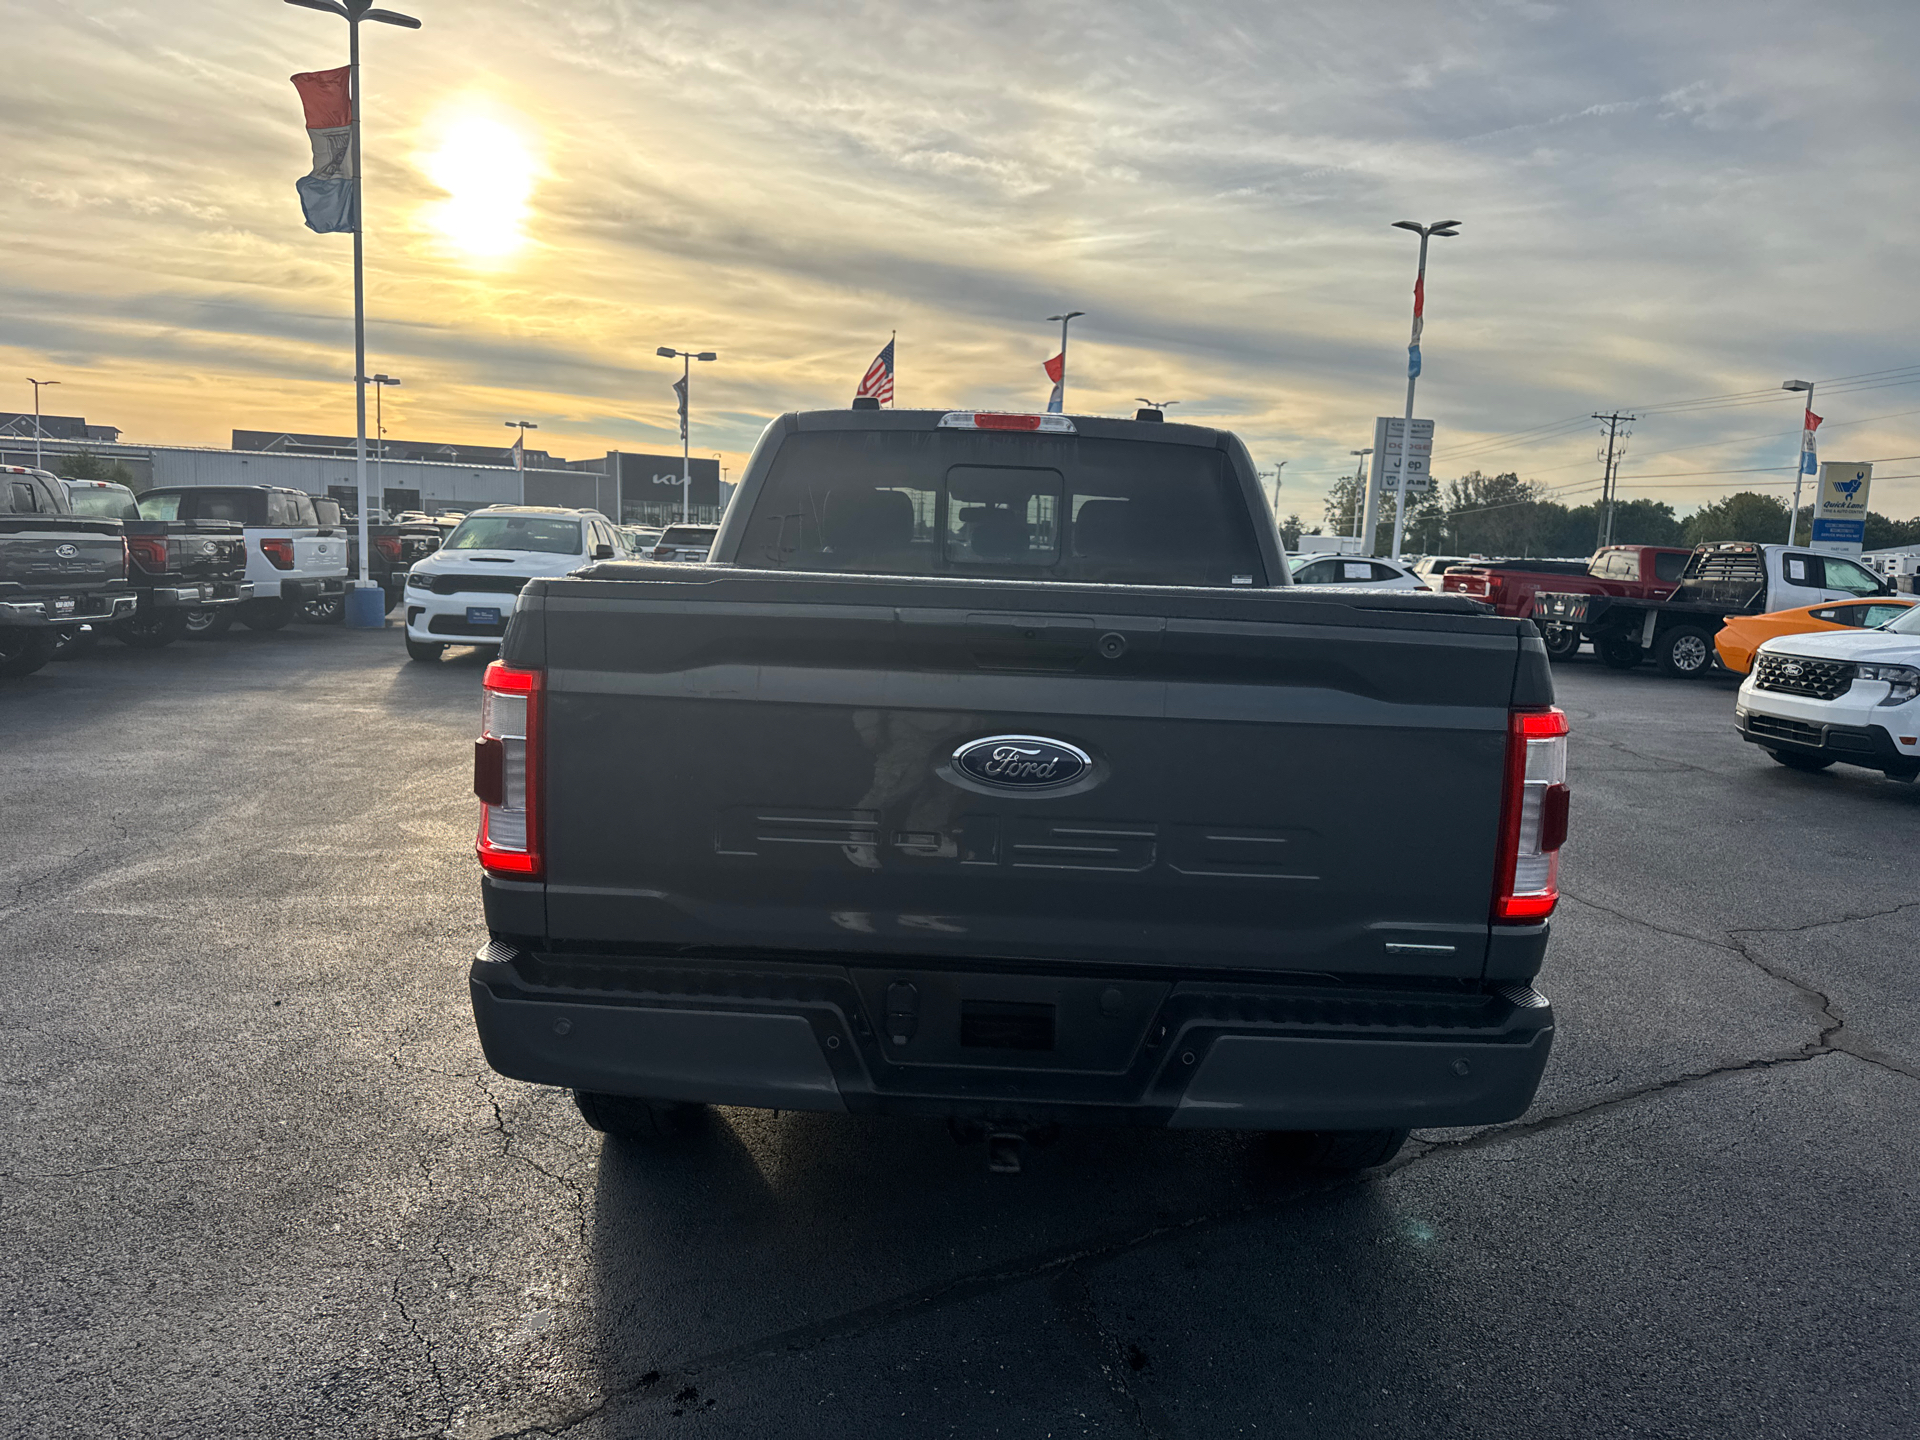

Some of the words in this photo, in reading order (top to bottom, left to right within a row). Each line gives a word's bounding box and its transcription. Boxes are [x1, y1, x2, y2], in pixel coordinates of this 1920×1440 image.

[1393, 457, 1422, 471] Jep
[652, 474, 691, 485] KIA
[1823, 501, 1846, 509] Quick
[985, 746, 1059, 778] Ford
